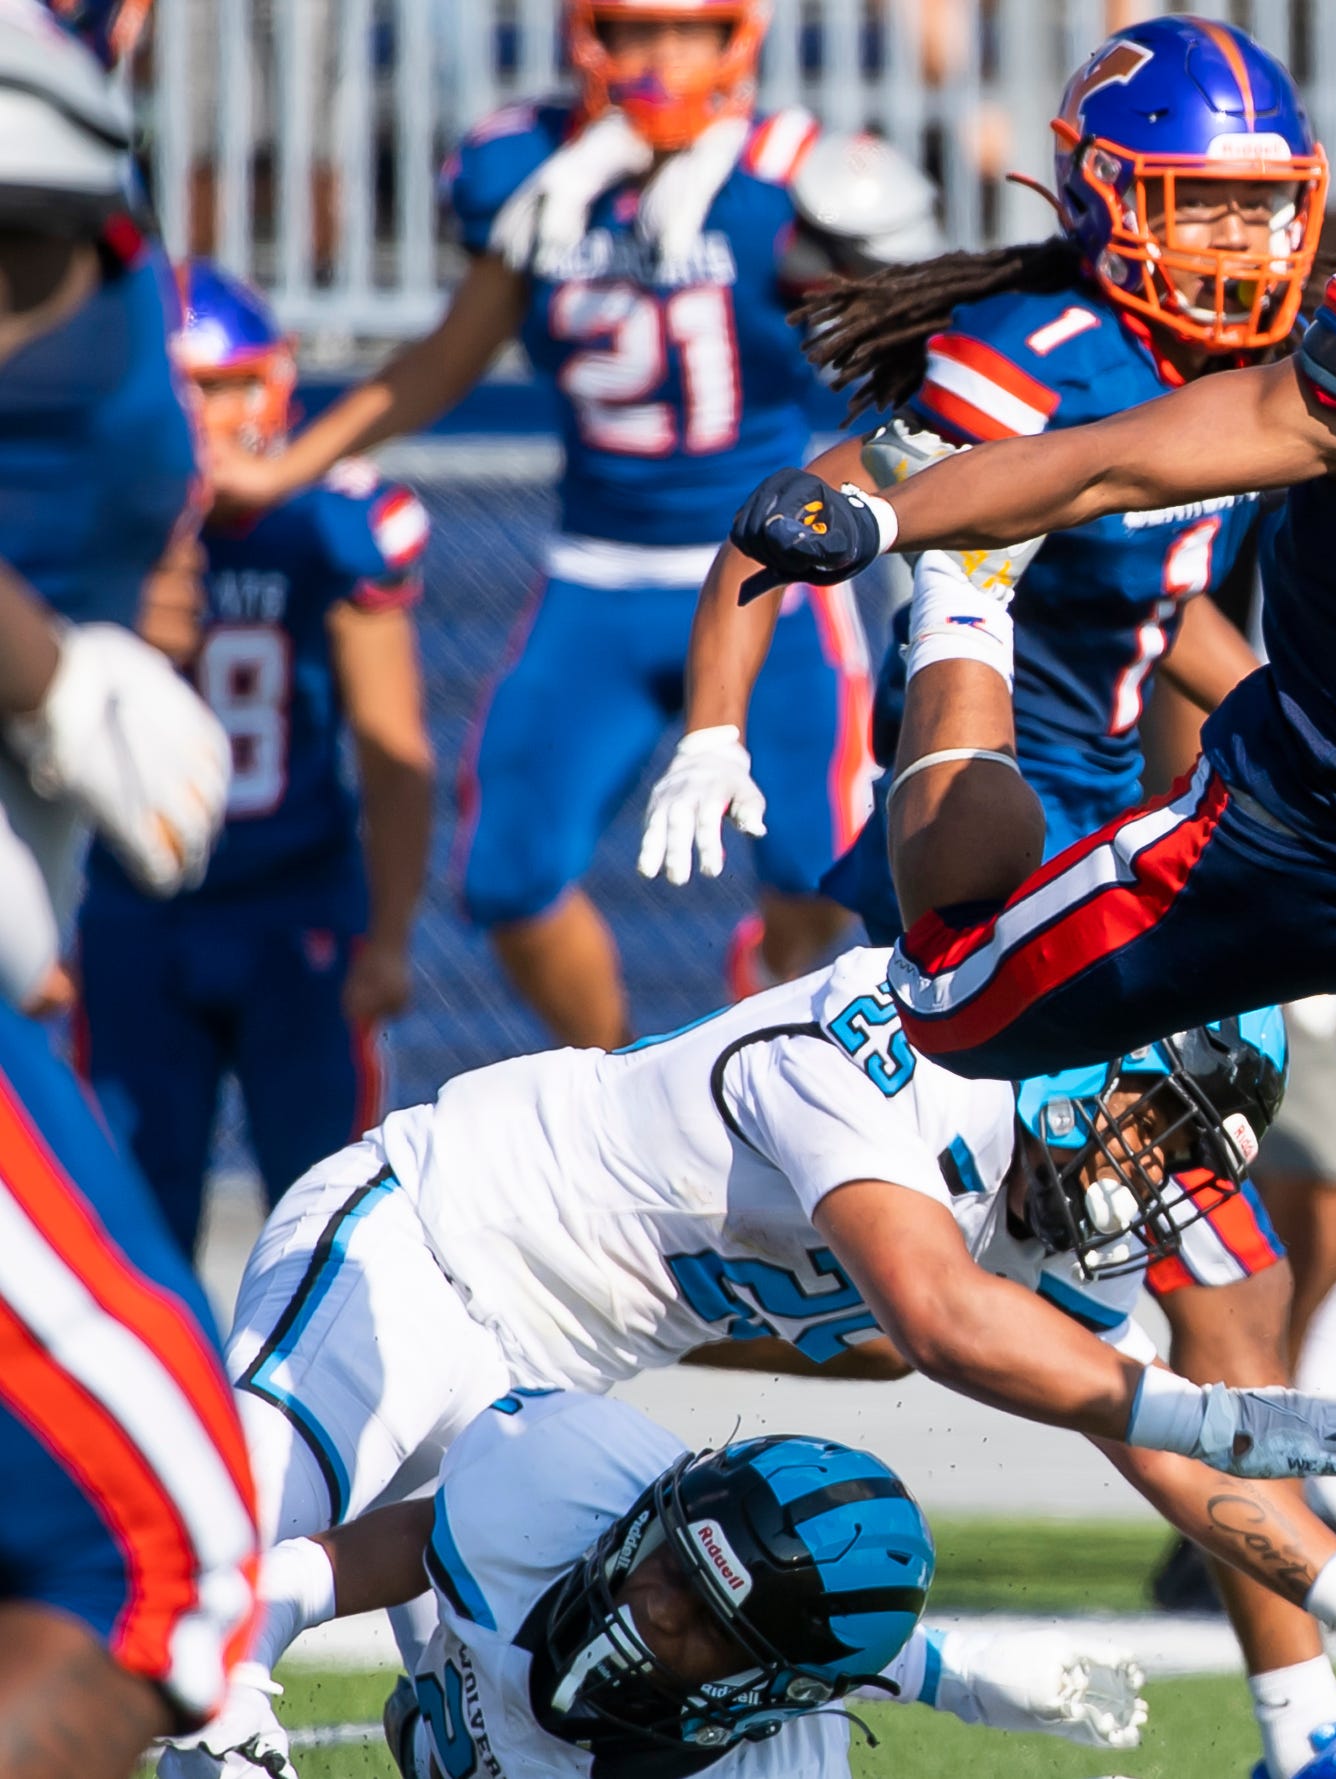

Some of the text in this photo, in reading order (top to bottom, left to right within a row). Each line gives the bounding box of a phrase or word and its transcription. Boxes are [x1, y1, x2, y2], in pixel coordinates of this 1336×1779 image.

[549, 279, 742, 458] 21
[1025, 305, 1101, 357] 1
[826, 980, 917, 1098] 25
[697, 1526, 745, 1590] Riddell
[459, 1643, 508, 1779] WOLVER
[700, 1683, 761, 1706] Ridell
